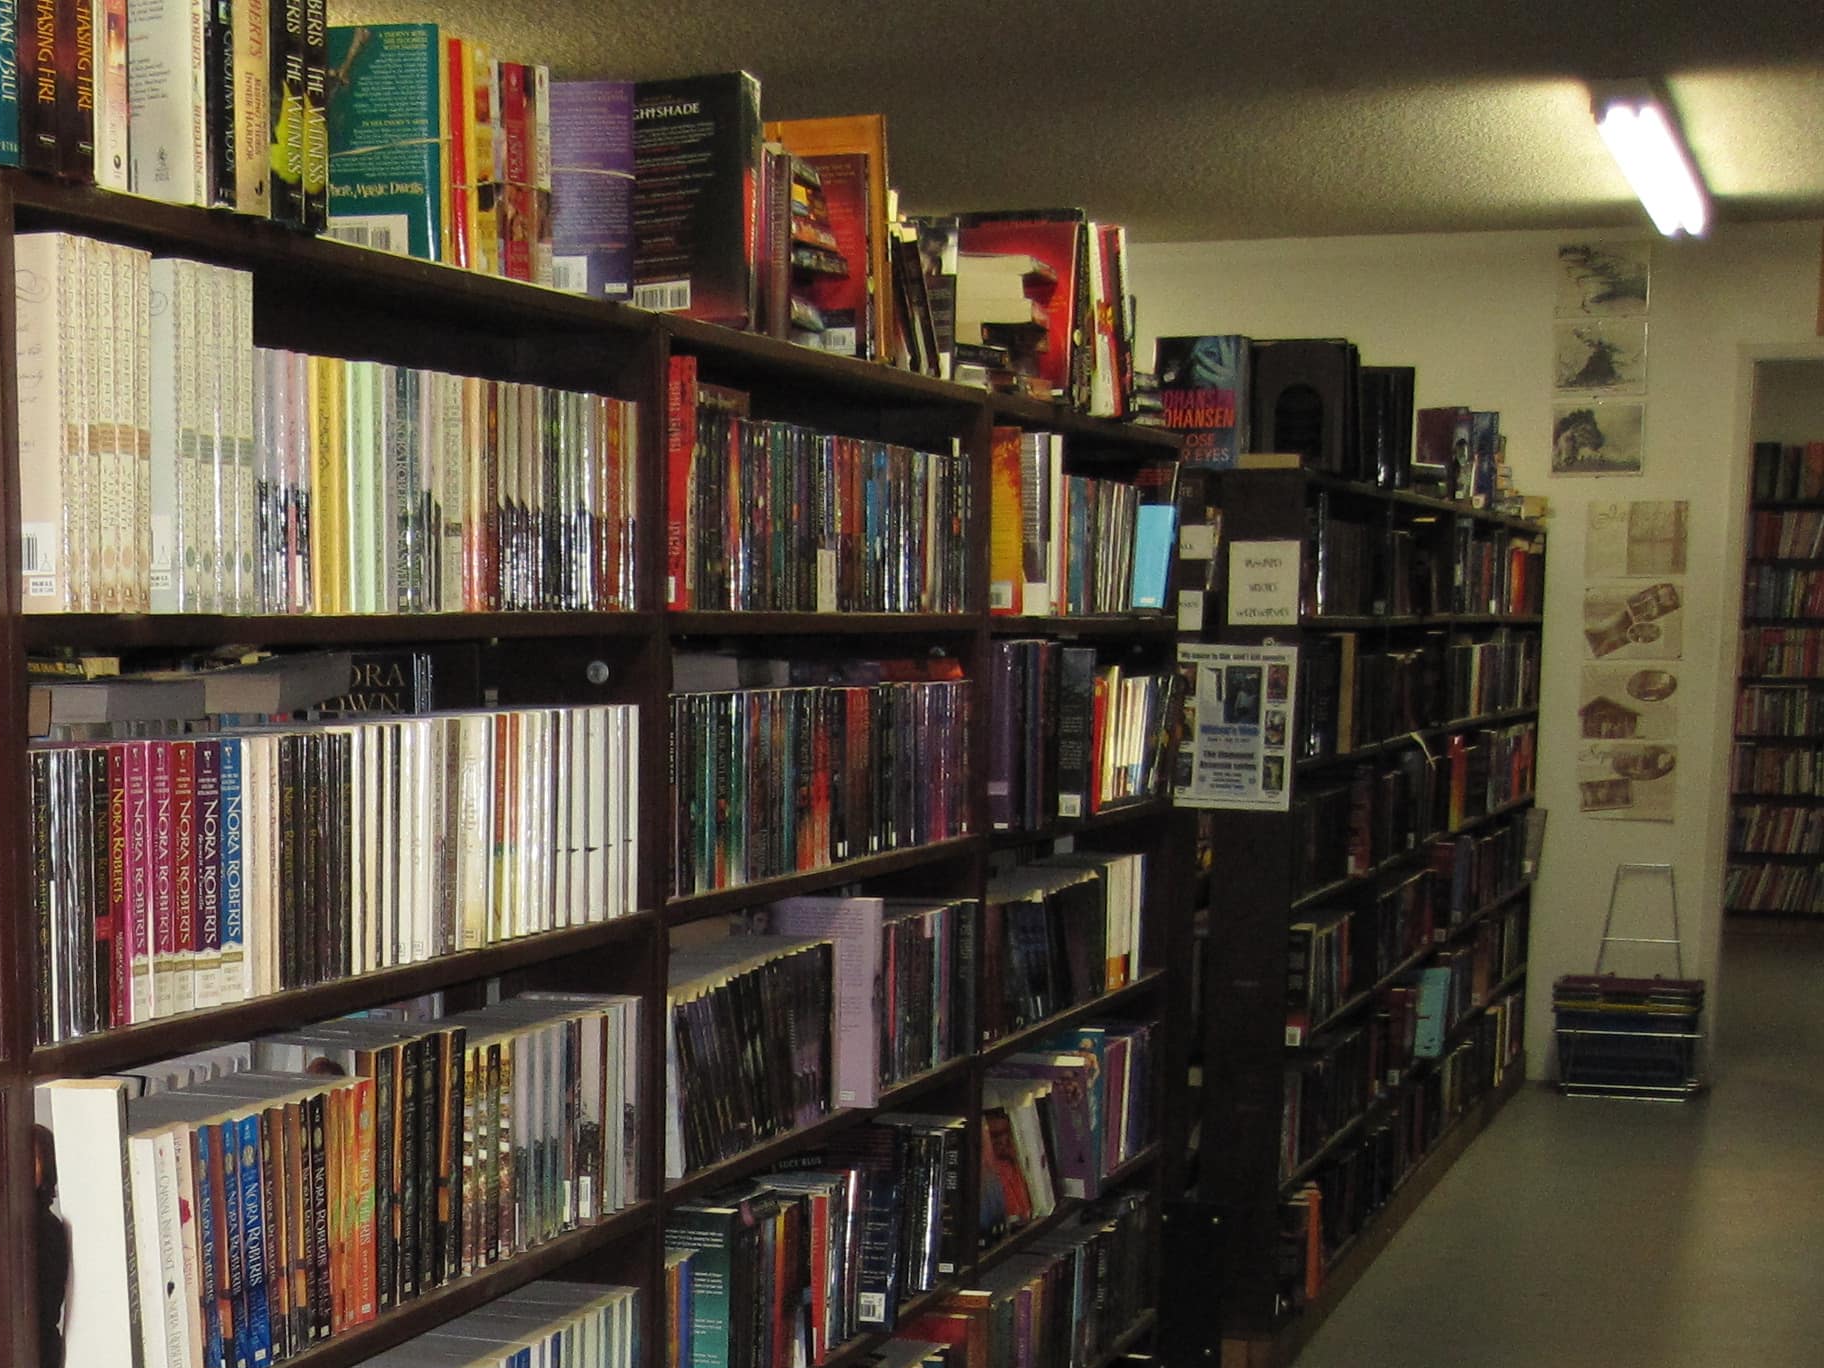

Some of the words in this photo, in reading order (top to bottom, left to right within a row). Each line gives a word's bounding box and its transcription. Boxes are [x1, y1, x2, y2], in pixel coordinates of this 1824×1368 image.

[39, 0, 56, 58] HASING
[38, 63, 56, 104] FIRE
[308, 63, 325, 97] THE
[634, 102, 700, 121] GHTSHADE
[1163, 405, 1235, 429] OHANSEN
[203, 800, 219, 862] NORA
[227, 795, 241, 855] NORA
[204, 868, 218, 944] ROBERTS
[228, 860, 241, 938] ROBERTS
[244, 1180, 258, 1224] NORA
[314, 1167, 325, 1210] NORA
[246, 1225, 262, 1288] ROBERTS
